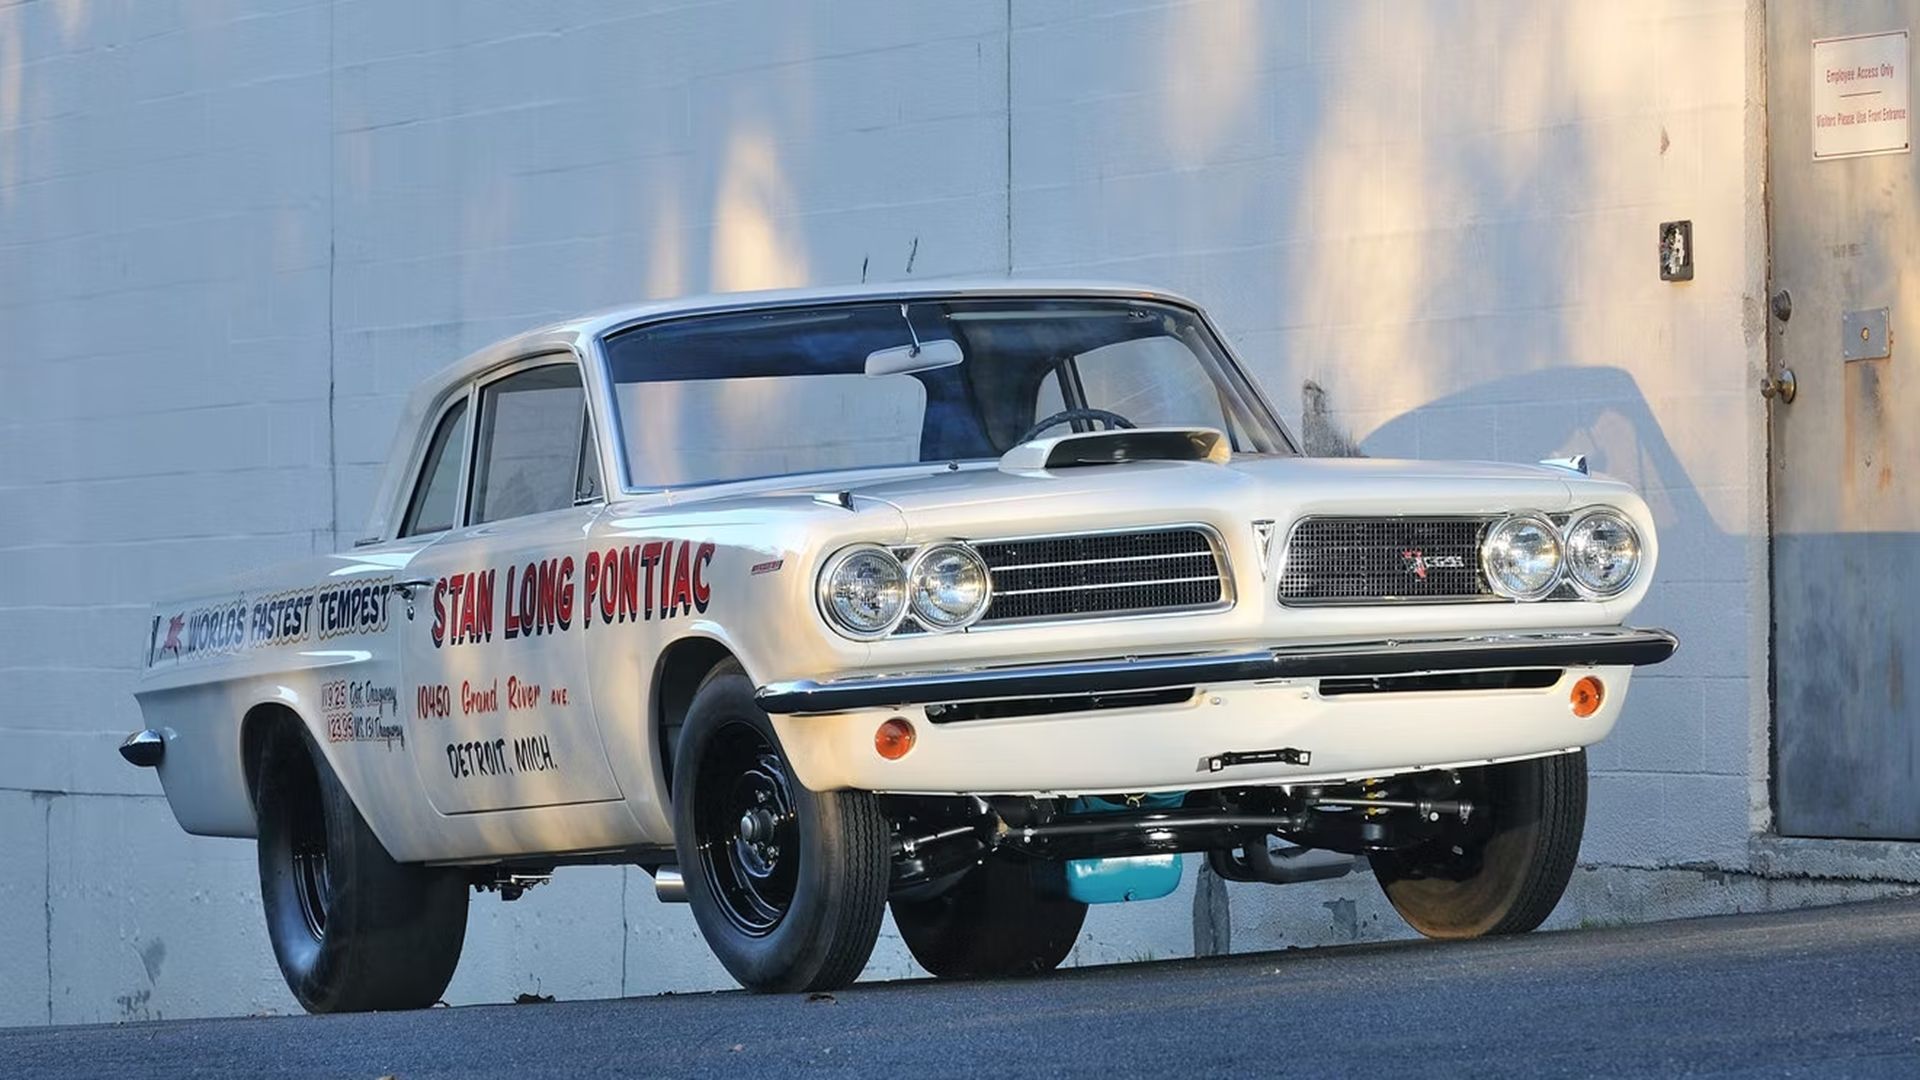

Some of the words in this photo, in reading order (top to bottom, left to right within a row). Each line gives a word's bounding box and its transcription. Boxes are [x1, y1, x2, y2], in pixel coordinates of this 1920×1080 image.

[1826, 68, 1855, 84] Employee
[1857, 66, 1879, 79] Access
[1881, 63, 1894, 79] Only
[250, 594, 313, 645] FASTEST
[318, 584, 391, 632] TEMPEST
[431, 568, 496, 649] STAN
[504, 555, 575, 640] LONG
[583, 539, 716, 630] PONTIAC
[417, 685, 450, 719] 10450
[461, 678, 498, 715] Grand
[507, 675, 541, 710] River
[514, 735, 558, 773] MICH.
